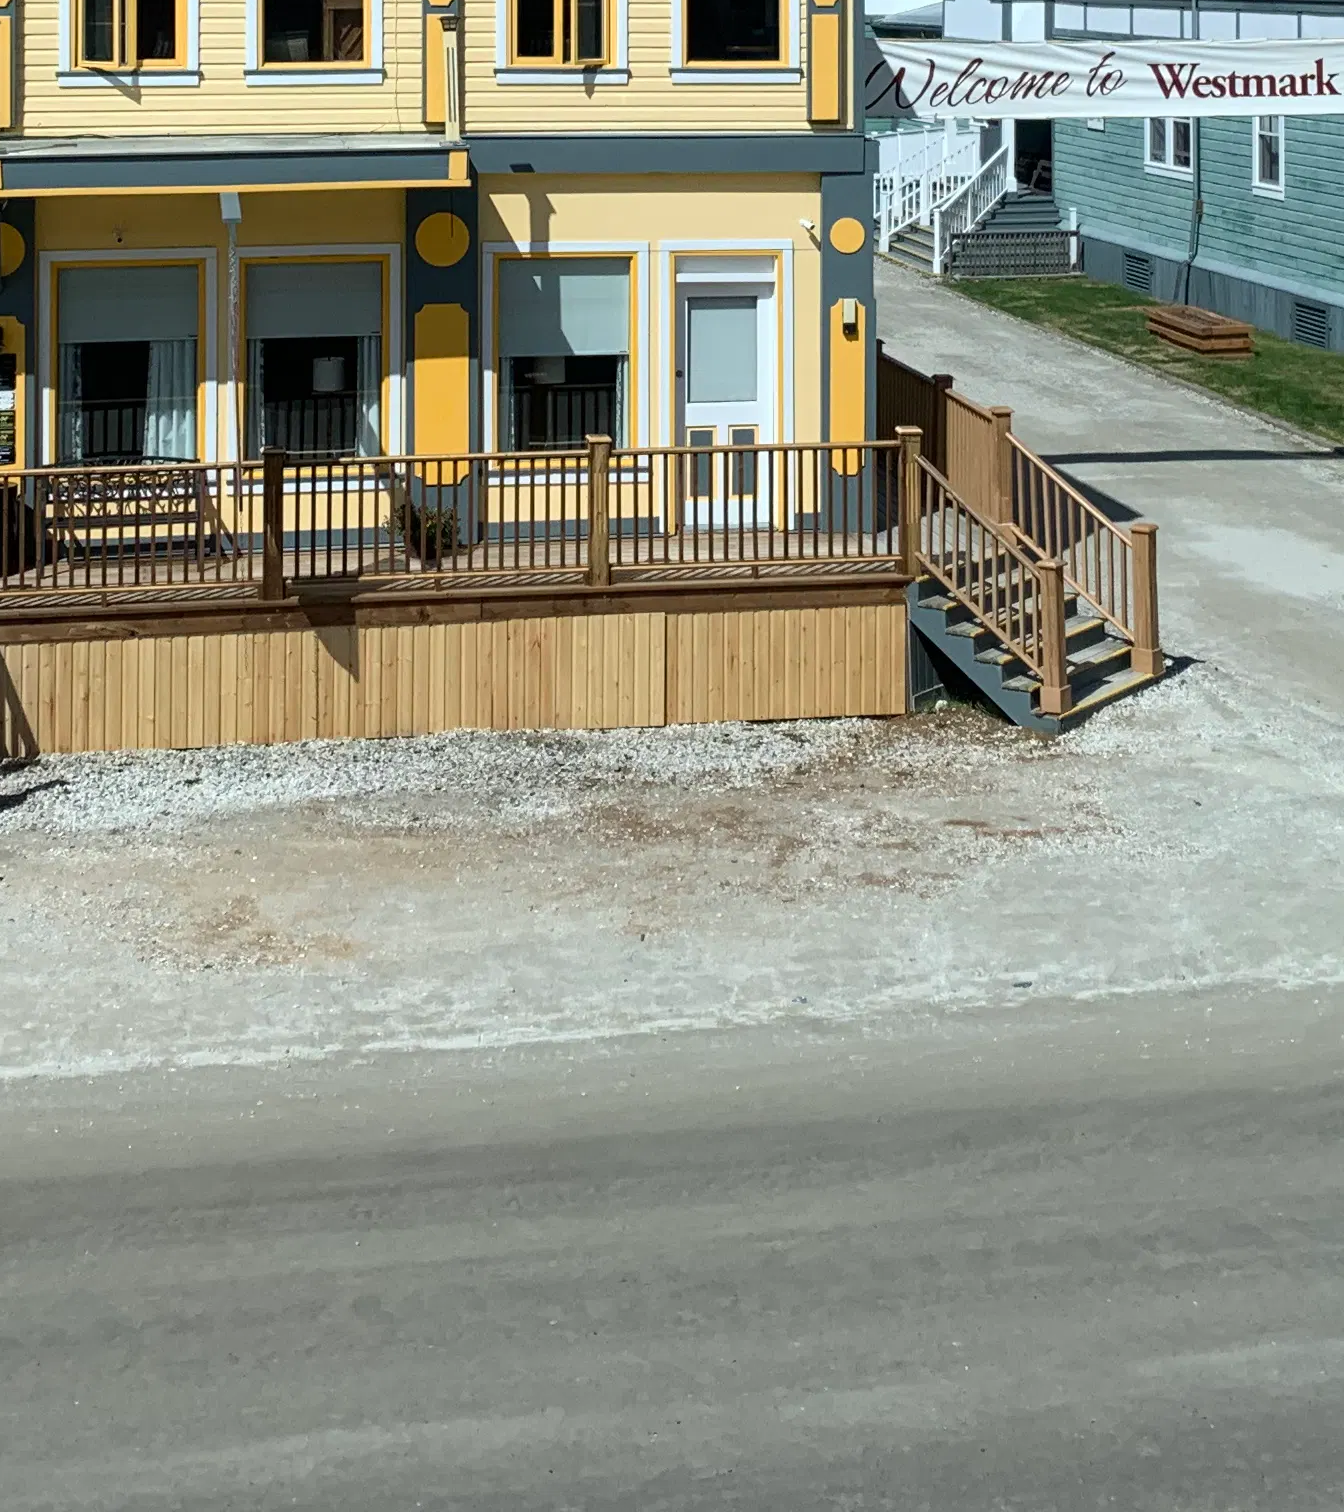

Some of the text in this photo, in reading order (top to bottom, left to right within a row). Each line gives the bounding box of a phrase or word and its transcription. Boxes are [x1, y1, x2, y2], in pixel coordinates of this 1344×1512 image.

[864, 56, 1074, 110] Welcome
[1086, 50, 1129, 97] to
[1147, 58, 1342, 100] Westmark
